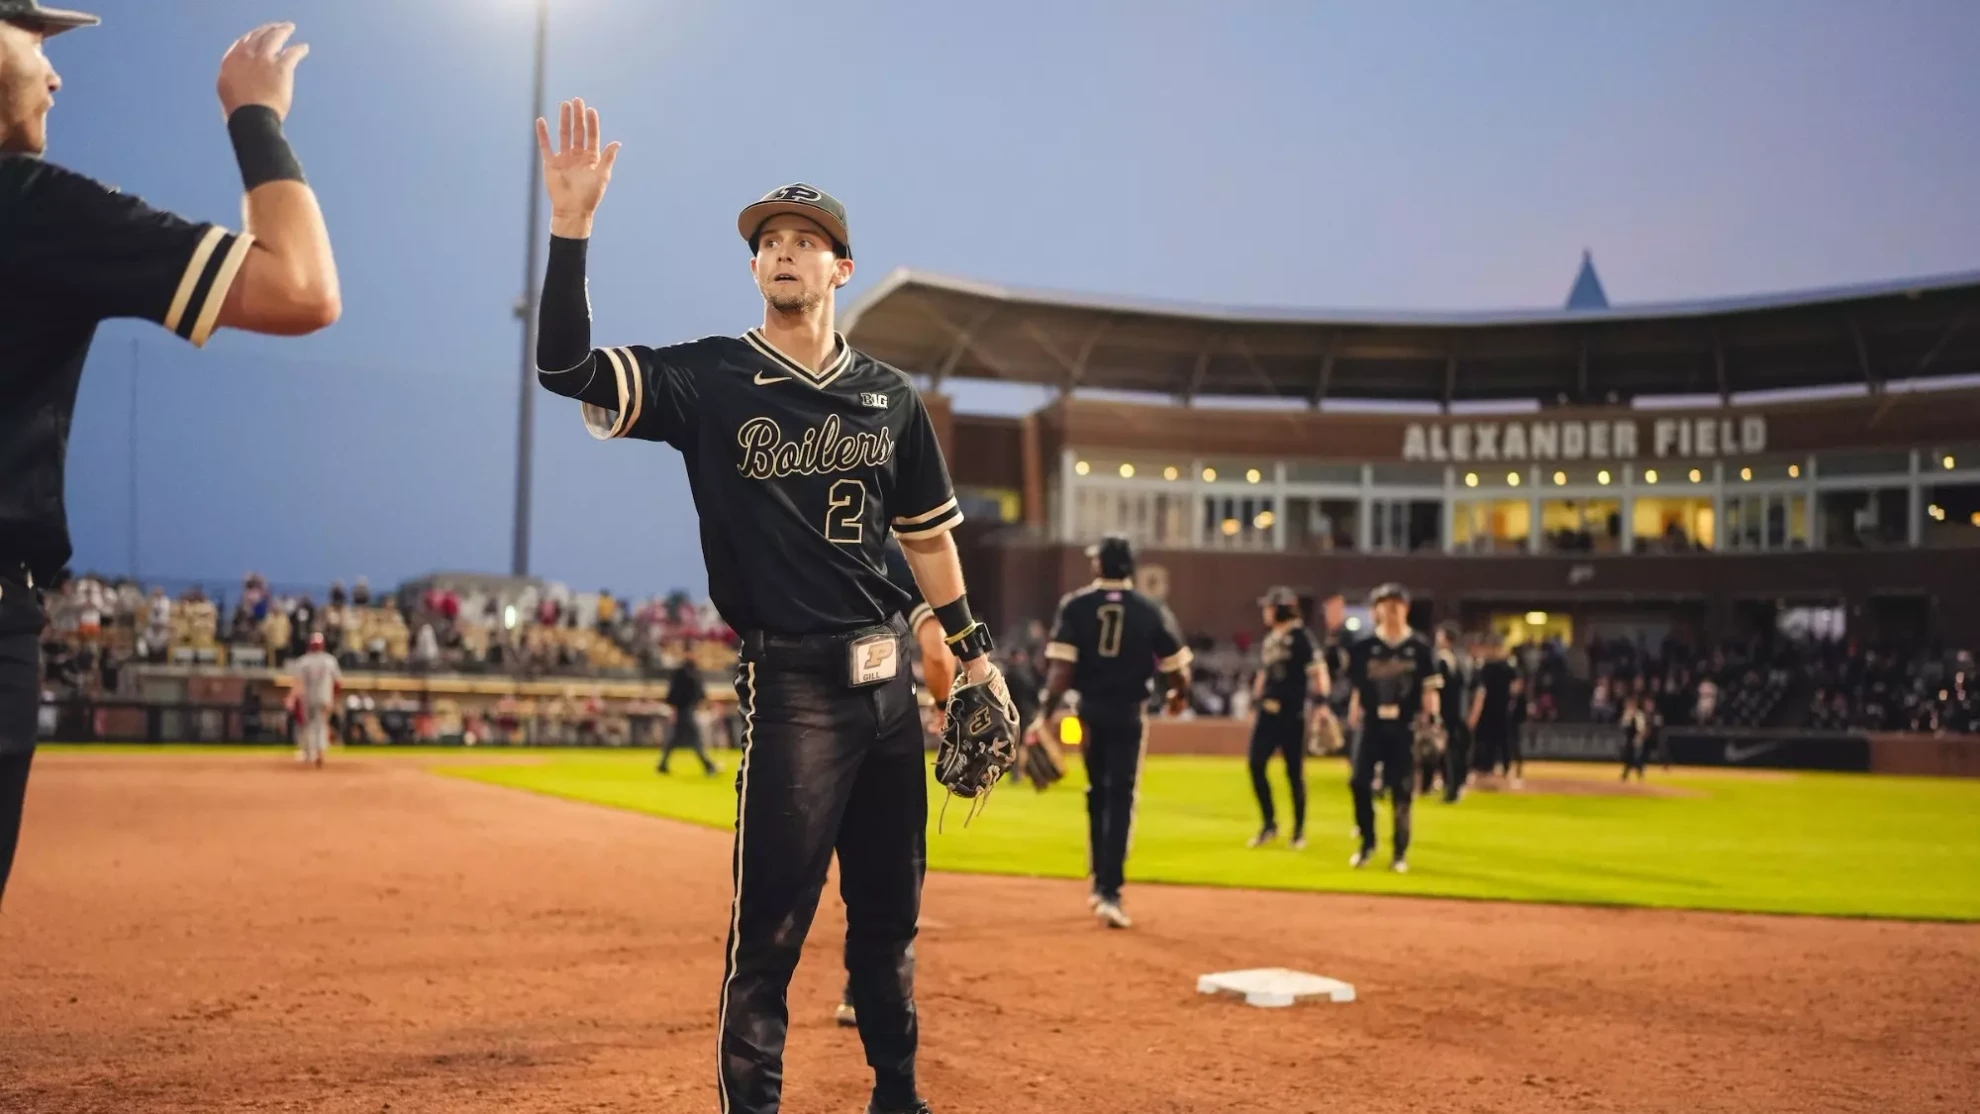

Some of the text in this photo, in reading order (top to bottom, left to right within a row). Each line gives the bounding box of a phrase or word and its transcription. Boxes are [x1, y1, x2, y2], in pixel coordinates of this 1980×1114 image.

[776, 185, 822, 201] P
[737, 414, 894, 479] Boilers
[1403, 416, 1766, 461] ALEXANDER FIELD
[825, 479, 866, 543] 2
[1096, 604, 1125, 658] 1
[863, 641, 894, 669] P
[863, 672, 880, 681] GILL
[969, 706, 992, 735] P
